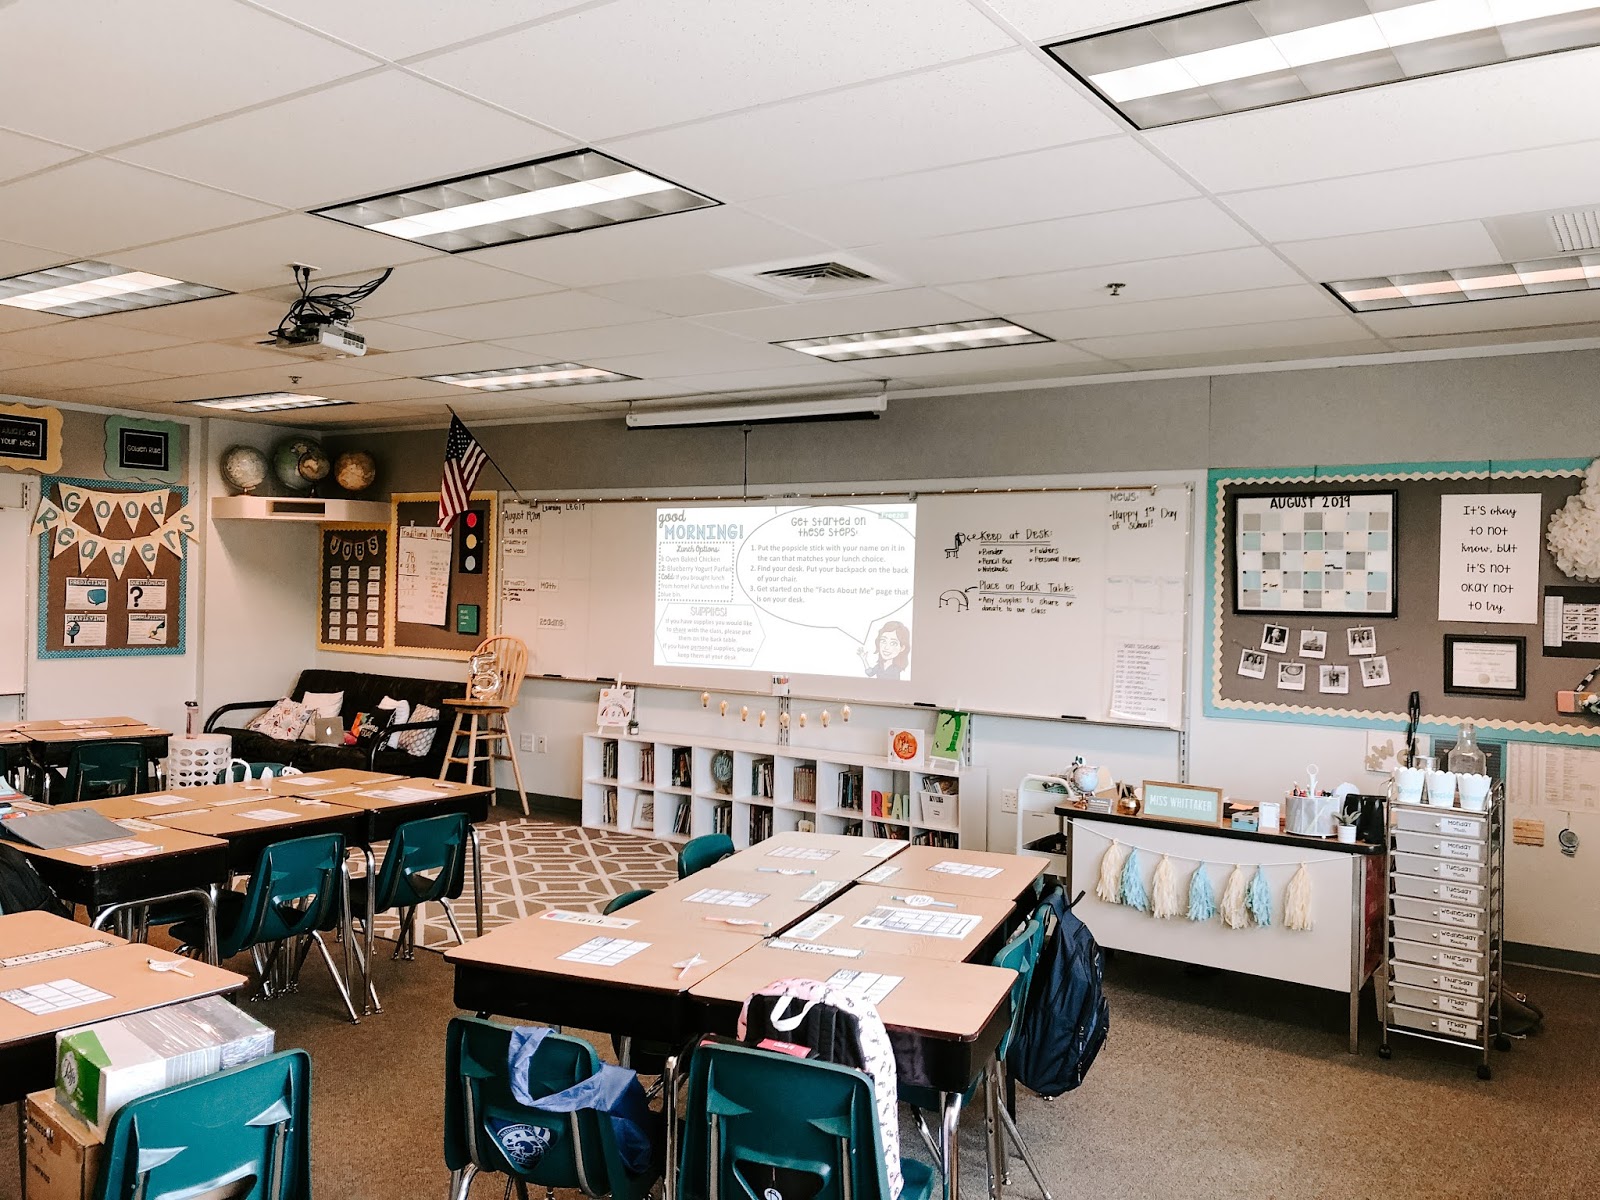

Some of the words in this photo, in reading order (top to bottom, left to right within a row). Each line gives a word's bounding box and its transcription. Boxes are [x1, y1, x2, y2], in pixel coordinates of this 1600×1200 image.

[127, 445, 148, 453] Golden
[148, 446, 161, 454] Rule
[64, 492, 164, 519] Good
[1270, 497, 1315, 509] AUGUST
[1322, 496, 1351, 508] 2019
[505, 510, 524, 523] August
[1161, 508, 1177, 521] Day
[1463, 506, 1487, 516] It's
[1490, 506, 1517, 518] okay
[658, 510, 686, 528] good
[791, 517, 809, 526] Get
[812, 517, 850, 526] started
[854, 516, 866, 526] on
[665, 524, 743, 540] MORNING!
[798, 527, 825, 537] these
[1112, 522, 1120, 530] of
[1469, 527, 1483, 535] to
[1487, 526, 1508, 535] not
[36, 507, 195, 566] Readers
[980, 530, 1002, 542] Keep
[1009, 530, 1020, 539] at
[332, 538, 377, 554] JOBS
[1461, 543, 1493, 554] know,
[1497, 543, 1517, 553] but
[836, 566, 866, 574] backpack
[1466, 564, 1486, 573] it's
[1490, 564, 1511, 573] not
[979, 580, 1000, 590] Place
[1021, 581, 1040, 592] Back
[1048, 583, 1073, 593] Table:
[1461, 583, 1488, 594] okay
[1493, 584, 1514, 593] not
[1040, 598, 1059, 606] share
[1468, 602, 1482, 610] to
[1486, 601, 1506, 614] try.
[1150, 794, 1168, 807] MISS
[1170, 796, 1212, 812] WHITTAKER
